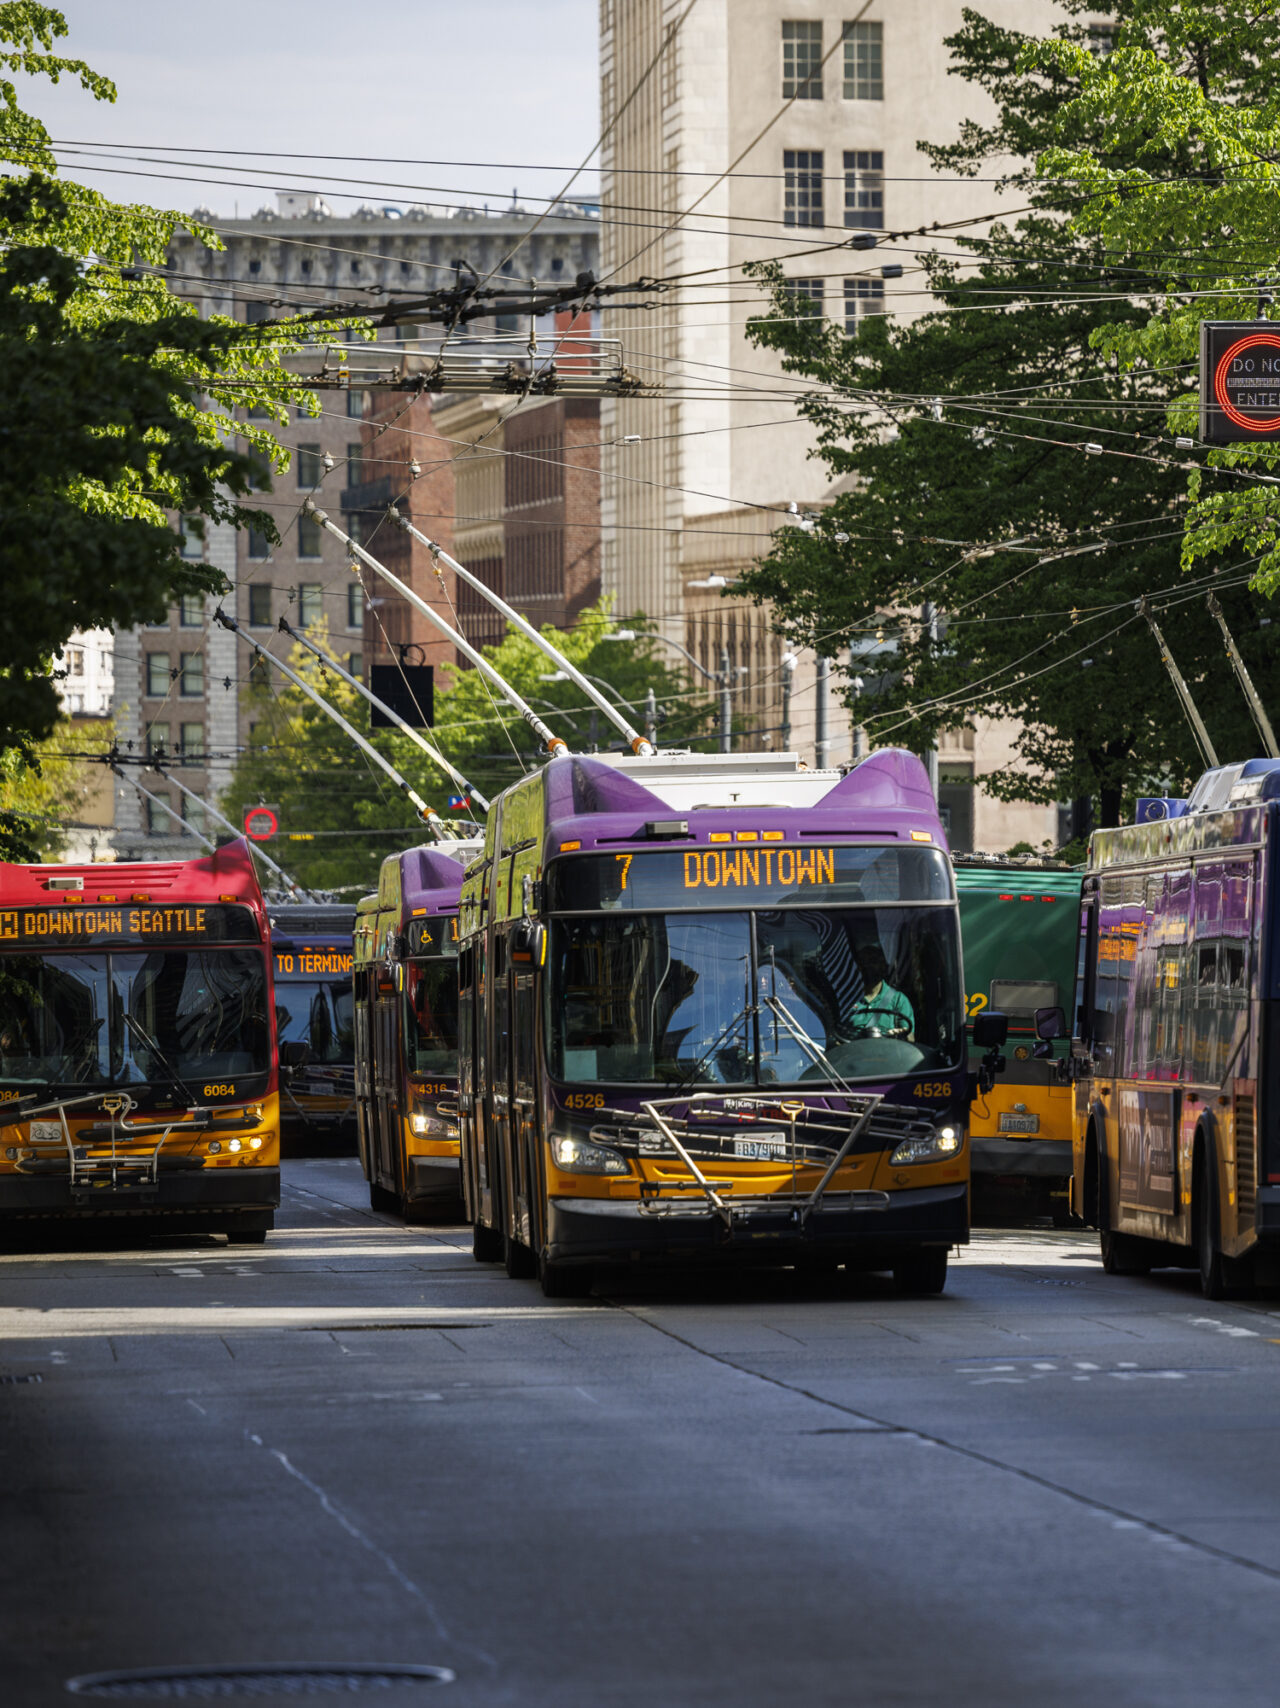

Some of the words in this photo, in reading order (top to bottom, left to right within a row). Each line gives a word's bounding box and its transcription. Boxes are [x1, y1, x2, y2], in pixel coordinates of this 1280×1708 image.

[1232, 358, 1255, 373] DO
[616, 854, 633, 889] 7
[684, 849, 834, 888] DOWNTOWN
[24, 911, 122, 935] DOWNTOWN
[129, 909, 206, 932] SEATTLE
[276, 954, 294, 974] TO
[203, 1085, 235, 1096] 6084
[418, 1083, 447, 1095] 4316
[913, 1083, 952, 1097] 4526
[564, 1094, 605, 1109] 4526
